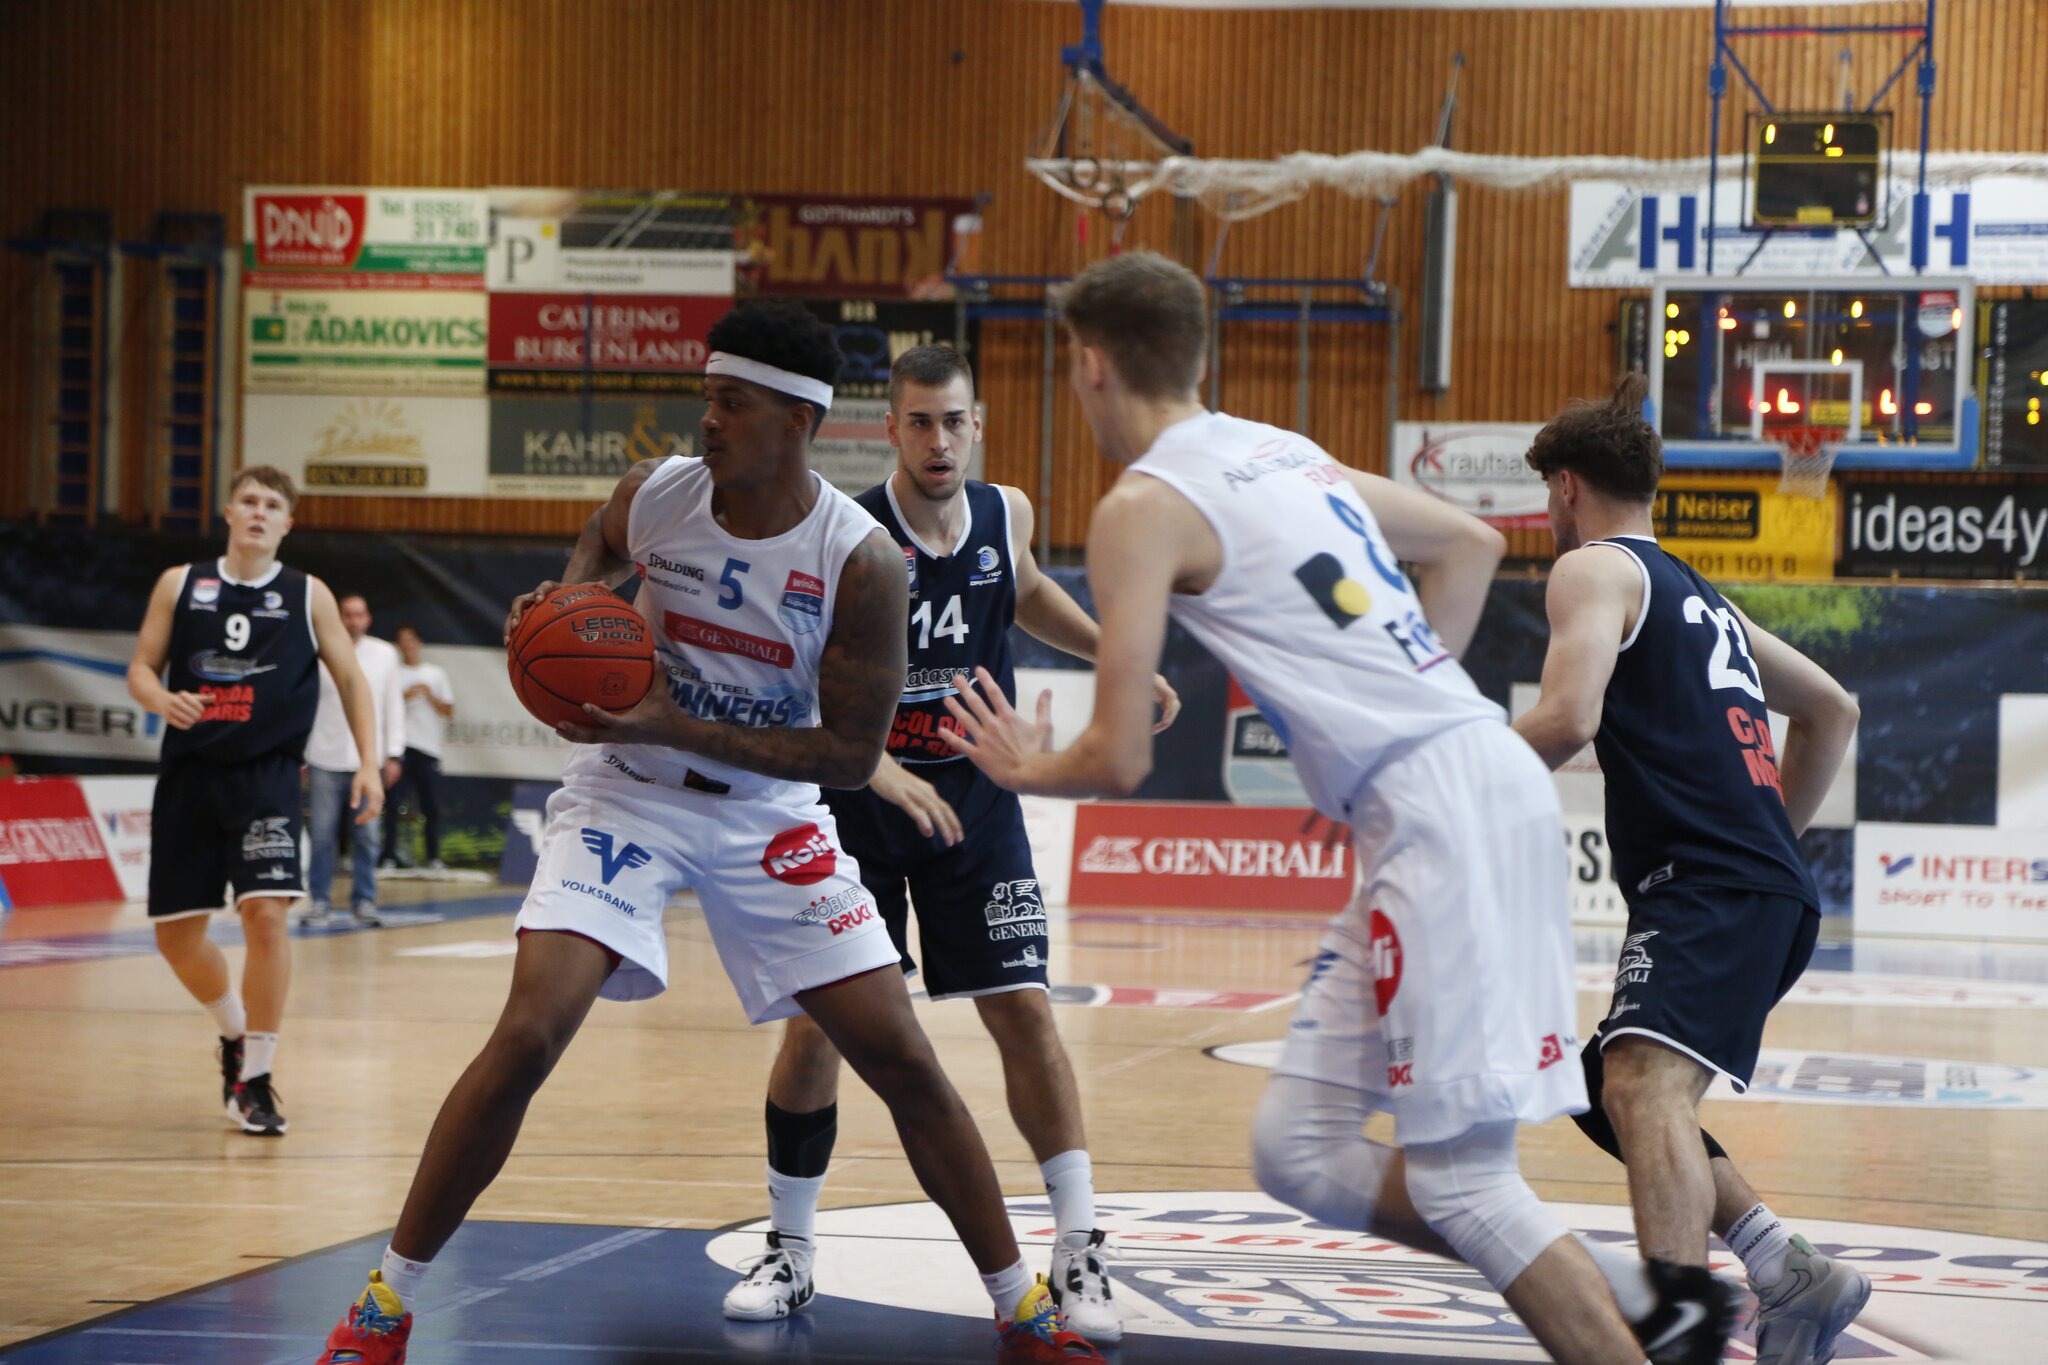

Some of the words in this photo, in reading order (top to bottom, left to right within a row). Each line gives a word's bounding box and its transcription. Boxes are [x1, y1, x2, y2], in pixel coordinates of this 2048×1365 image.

[305, 317, 486, 345] ADAKOVICS
[1676, 494, 1754, 520] Neiser
[648, 553, 705, 582] SPALDING
[717, 557, 751, 610] 5
[224, 613, 251, 651] 9
[570, 616, 645, 634] LEGACY
[911, 594, 970, 649] 14
[699, 626, 782, 663] GENERALI
[704, 680, 754, 697] STEEL
[604, 754, 657, 784] SPALDING
[1142, 838, 1346, 879] GENERALI
[561, 879, 637, 917] VOLKSBANK
